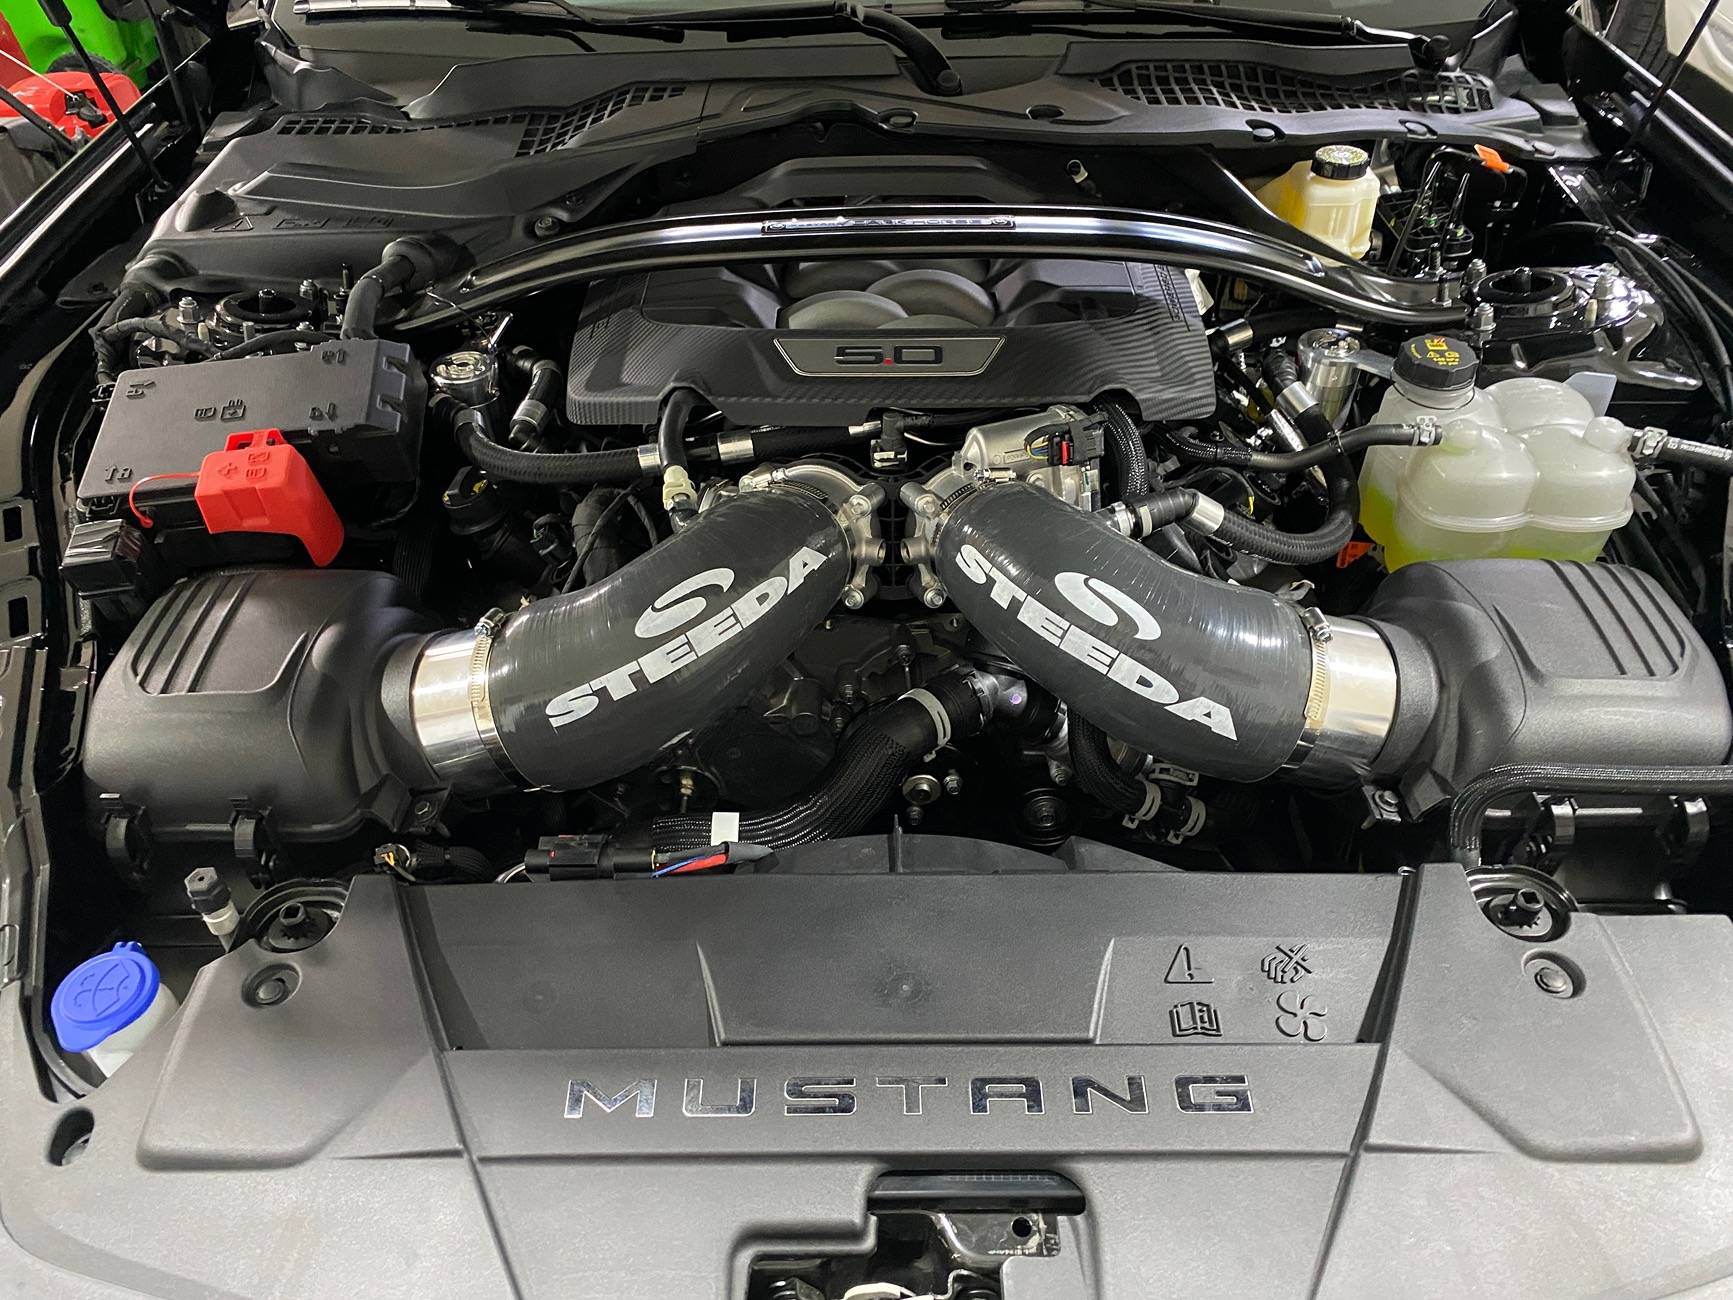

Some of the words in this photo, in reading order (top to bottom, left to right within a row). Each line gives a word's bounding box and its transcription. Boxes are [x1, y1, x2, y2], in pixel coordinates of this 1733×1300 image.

[835, 345, 944, 366] 5.0
[545, 546, 828, 728] STEEDA
[955, 544, 1238, 741] STEEDA
[563, 1074, 1255, 1119] MUSTANG
